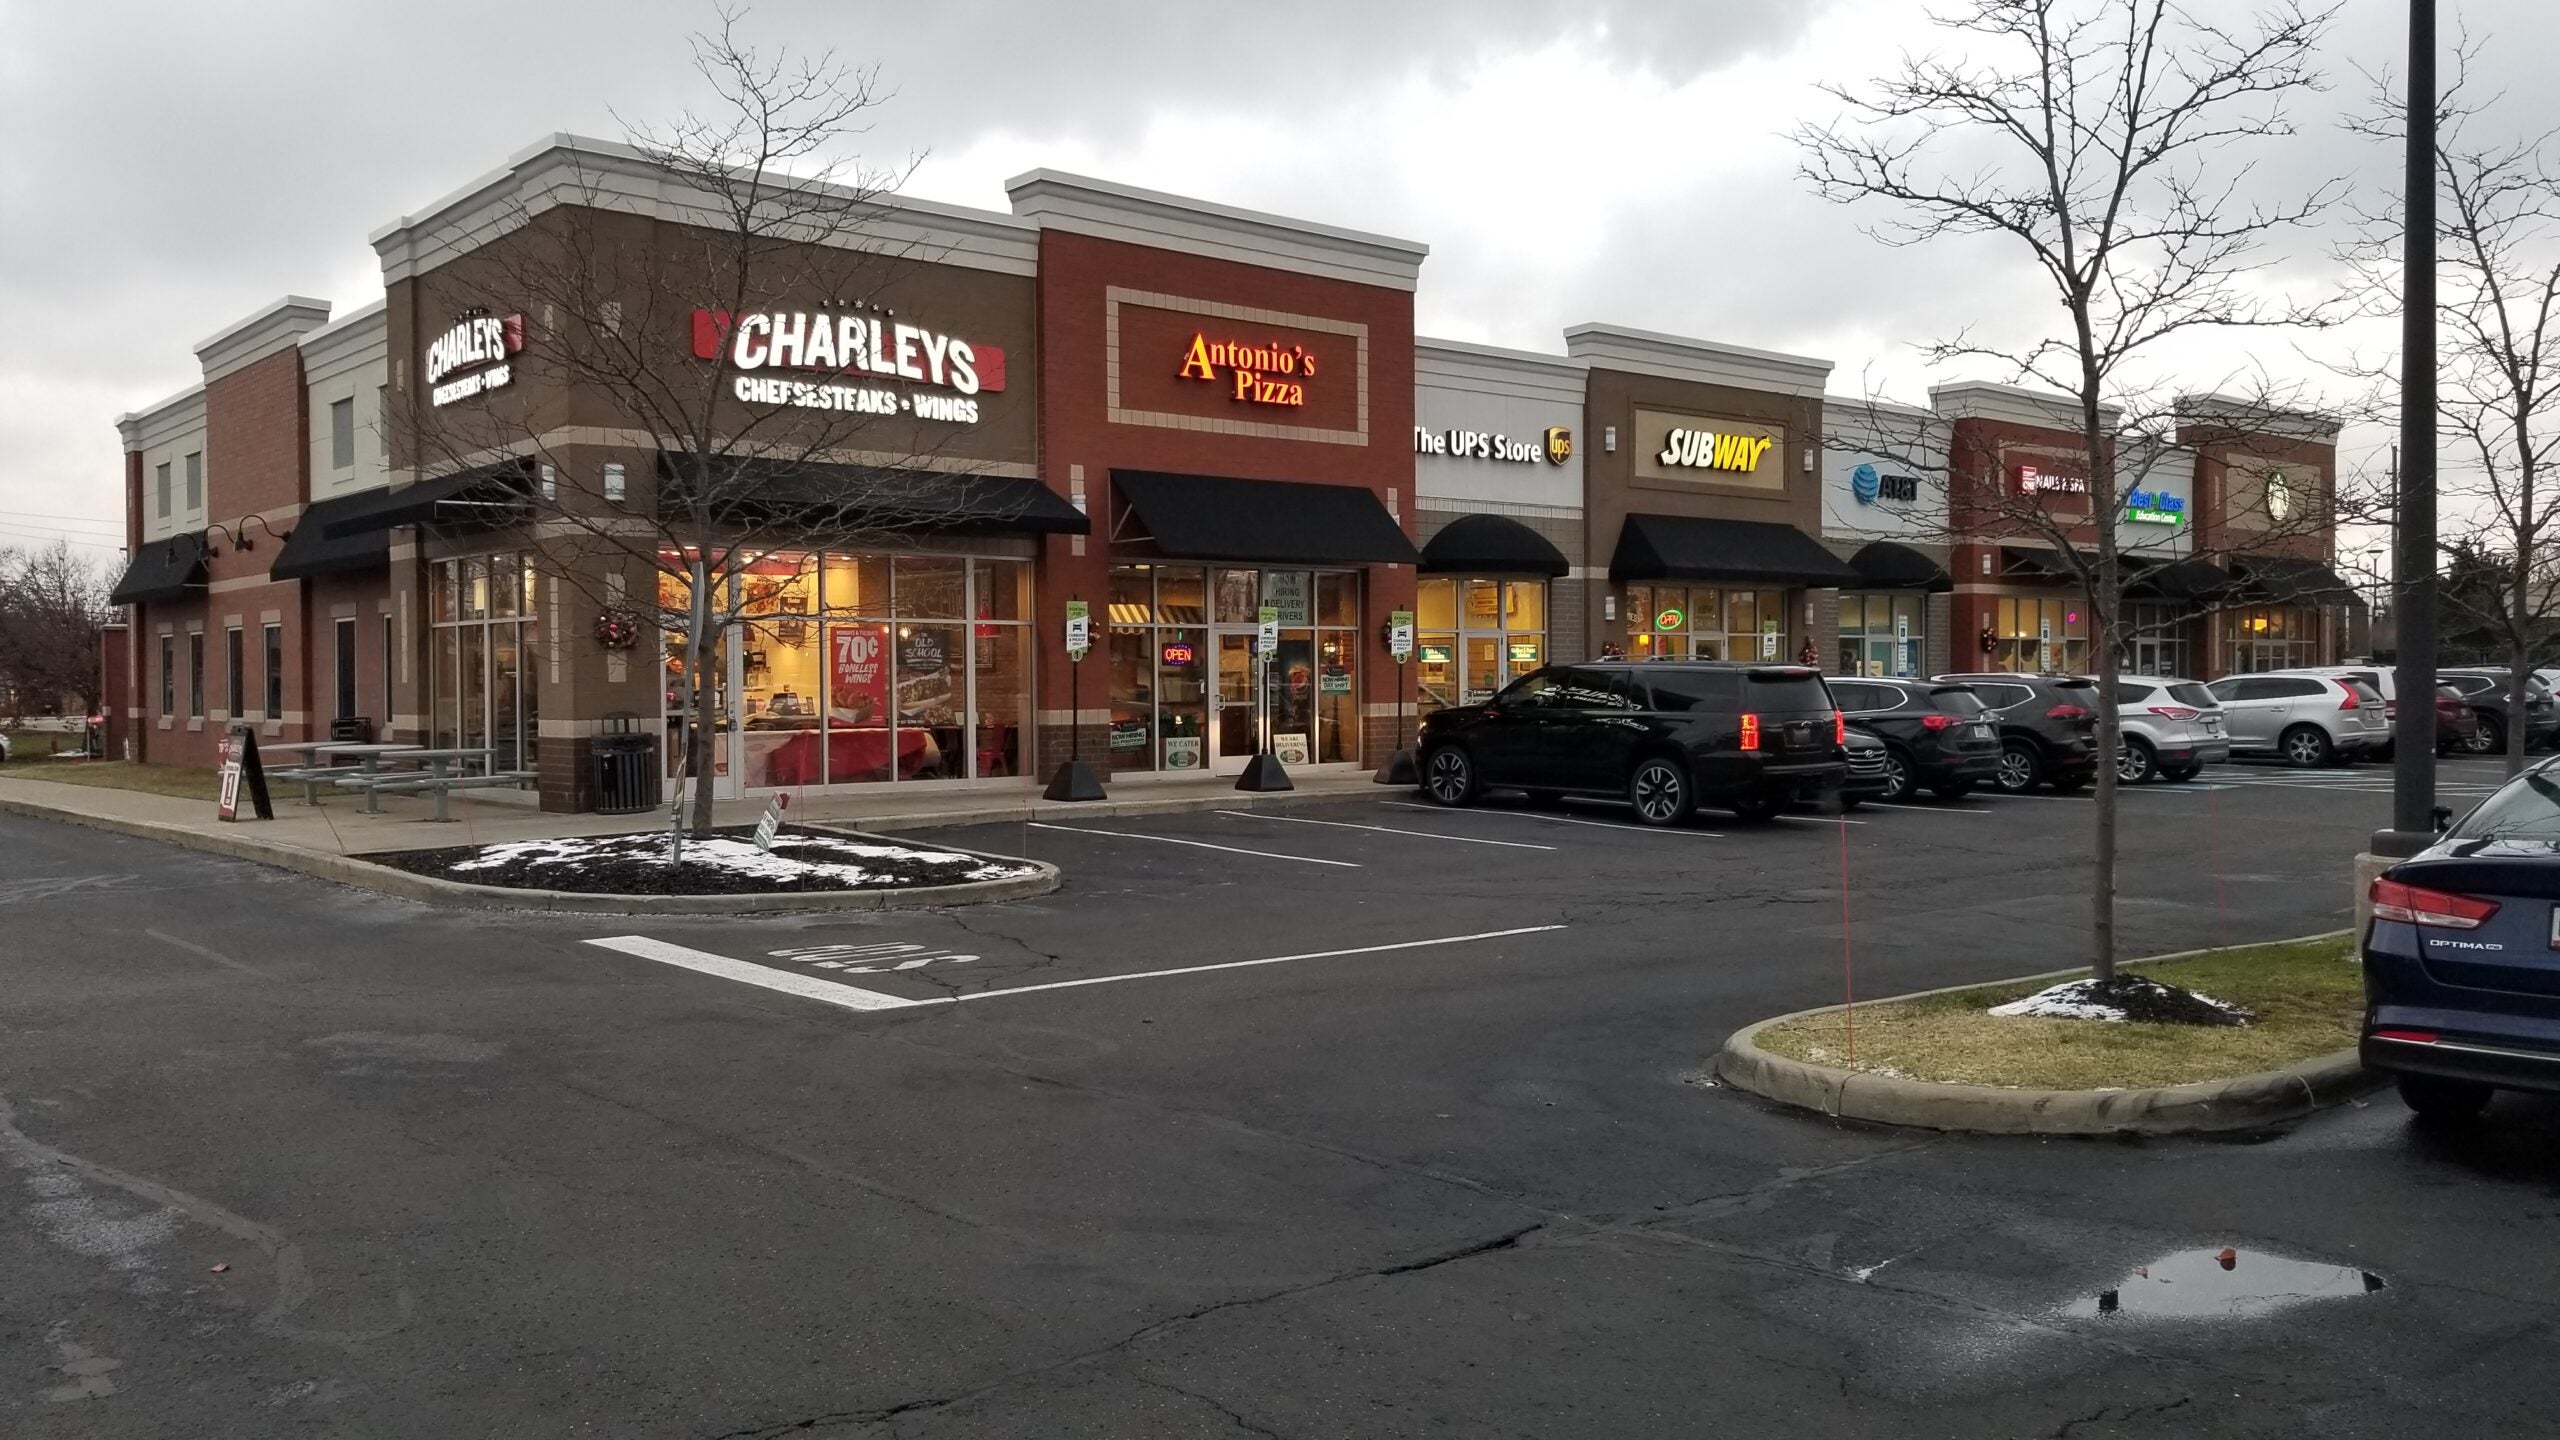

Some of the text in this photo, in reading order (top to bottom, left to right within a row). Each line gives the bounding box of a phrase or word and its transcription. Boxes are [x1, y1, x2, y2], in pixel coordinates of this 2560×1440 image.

[428, 318, 505, 384] CHARLEYS
[735, 312, 980, 395] CHARLEYS
[1179, 332, 1316, 380] Antonio's
[1234, 370, 1304, 406] Pizza
[735, 376, 979, 424] CHEESESTEAKS WINGS
[1414, 426, 1542, 463] The UPS Store
[1551, 439, 1570, 460] ups
[1660, 427, 1772, 473] SUBWAY
[1879, 475, 1920, 501] AT&T
[2036, 475, 2060, 490] NAILS
[2131, 489, 2151, 508] Best
[2160, 491, 2185, 511] Class
[2136, 510, 2160, 522] Education
[1275, 587, 1300, 597] HIRING
[1270, 599, 1305, 609] DELIVERY
[1277, 611, 1303, 621] RIVERS
[915, 637, 934, 648] OLD
[905, 647, 943, 658] SCHOOL
[1165, 648, 1192, 661] OPEN
[838, 663, 879, 674] BONELESS
[1179, 740, 1199, 748] CATER
[2429, 939, 2485, 950] OPTIMA
